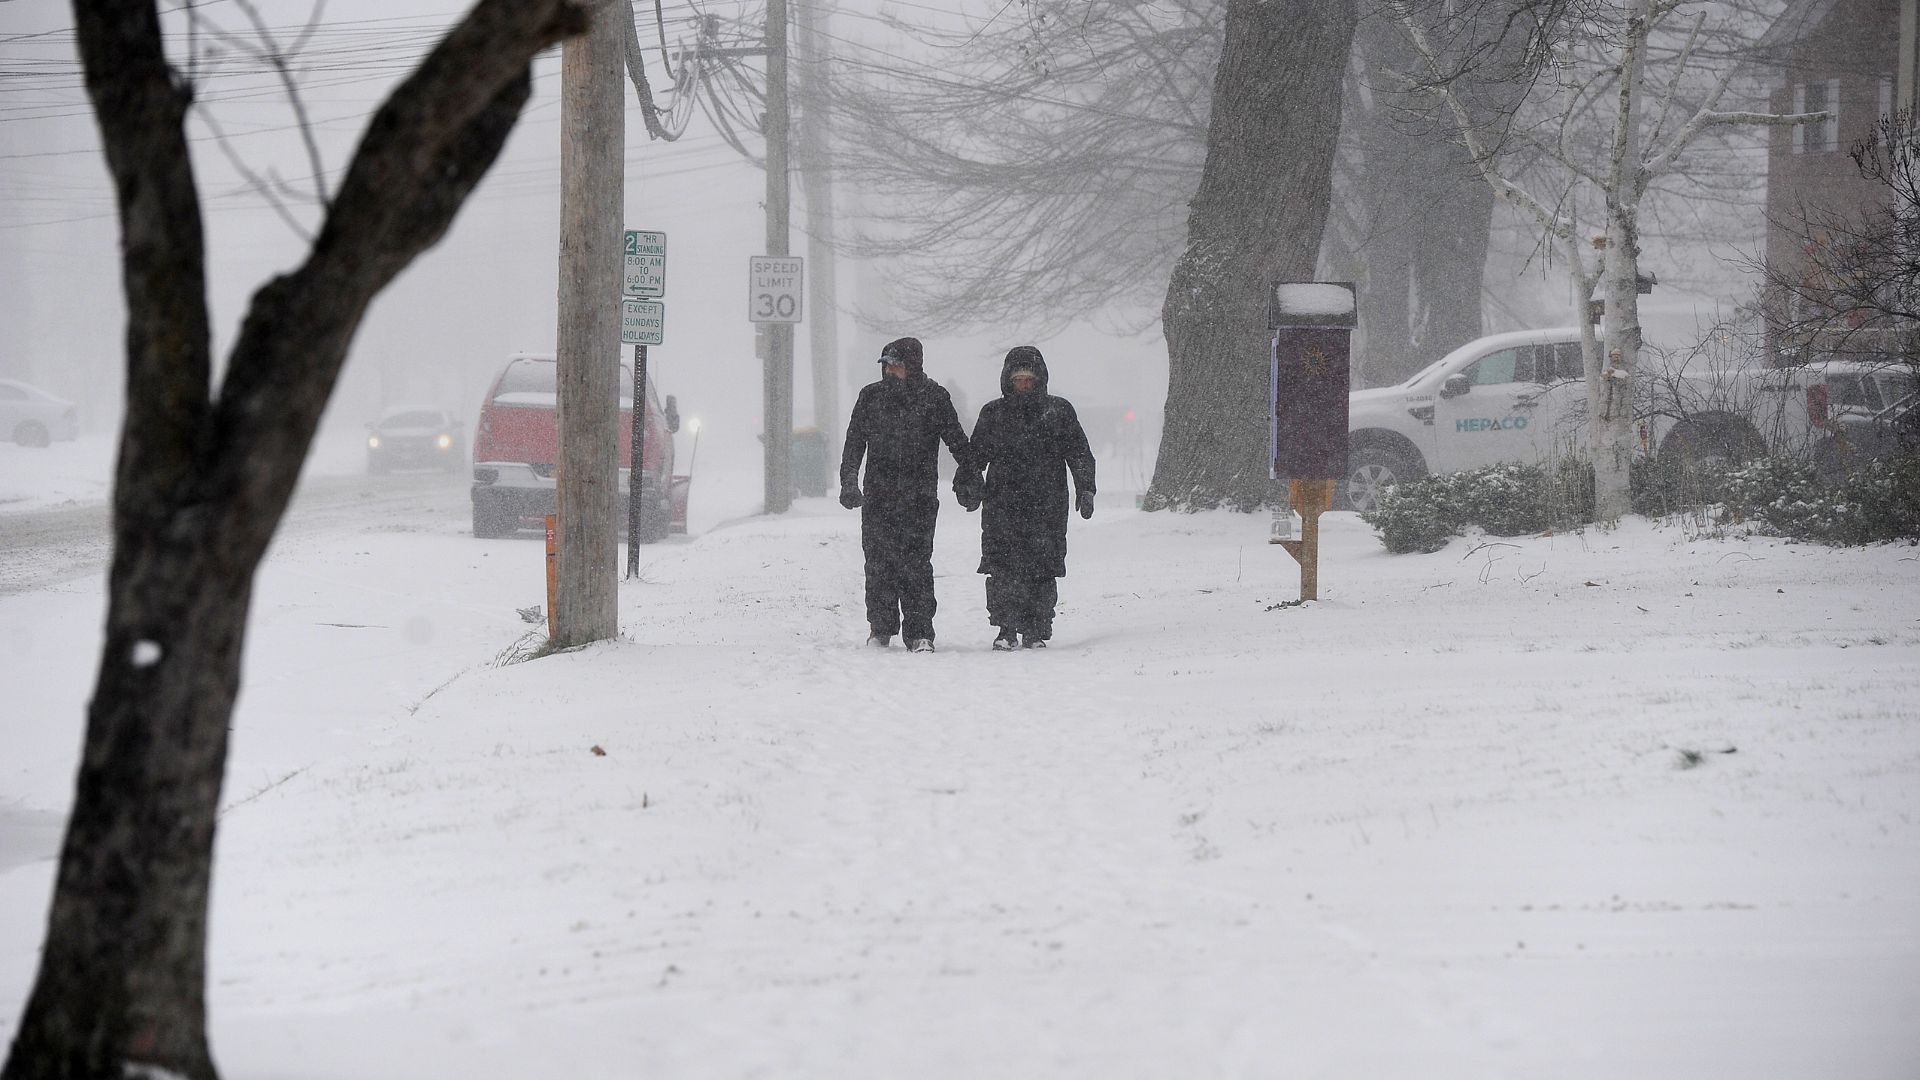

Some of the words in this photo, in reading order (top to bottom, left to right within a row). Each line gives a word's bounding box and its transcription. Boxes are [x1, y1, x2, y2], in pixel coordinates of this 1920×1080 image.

[625, 235, 635, 252] 2
[636, 245, 664, 254] STANDING
[627, 257, 646, 266] 8:00
[650, 258, 662, 267] AM
[754, 262, 799, 273] SPEED
[640, 267, 649, 275] TO
[627, 275, 646, 284] 6:00
[649, 276, 661, 285] PM
[758, 277, 794, 288] LIMIT
[628, 304, 657, 314] EXCEPT
[756, 294, 795, 318] 30
[625, 317, 660, 328] SUNDAYS
[623, 330, 660, 341] HOLIDAYS
[1455, 416, 1528, 433] HEPACO
